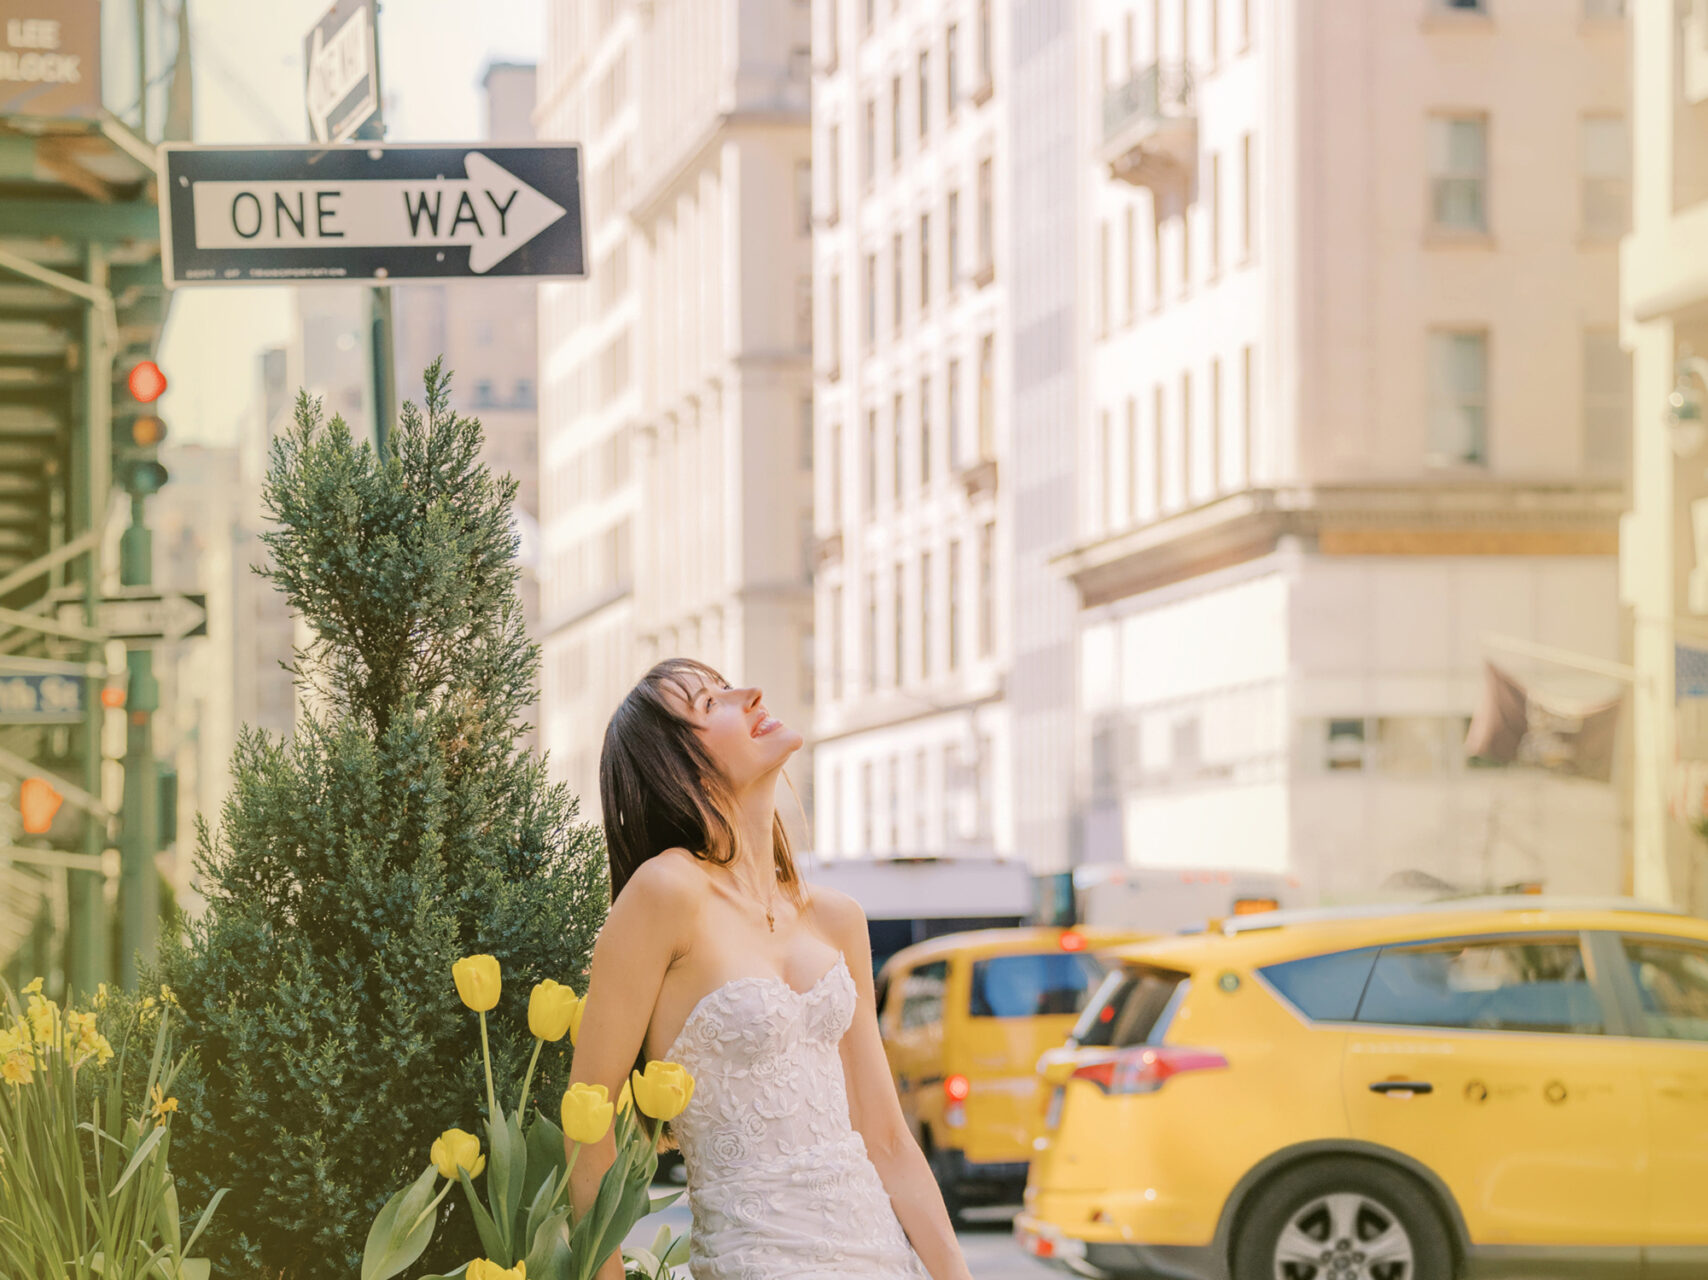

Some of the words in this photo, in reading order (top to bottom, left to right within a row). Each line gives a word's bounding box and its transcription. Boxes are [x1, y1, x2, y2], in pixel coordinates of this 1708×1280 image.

[0, 51, 80, 83] LOCK
[232, 191, 345, 238] ONE
[404, 189, 519, 237] WAY
